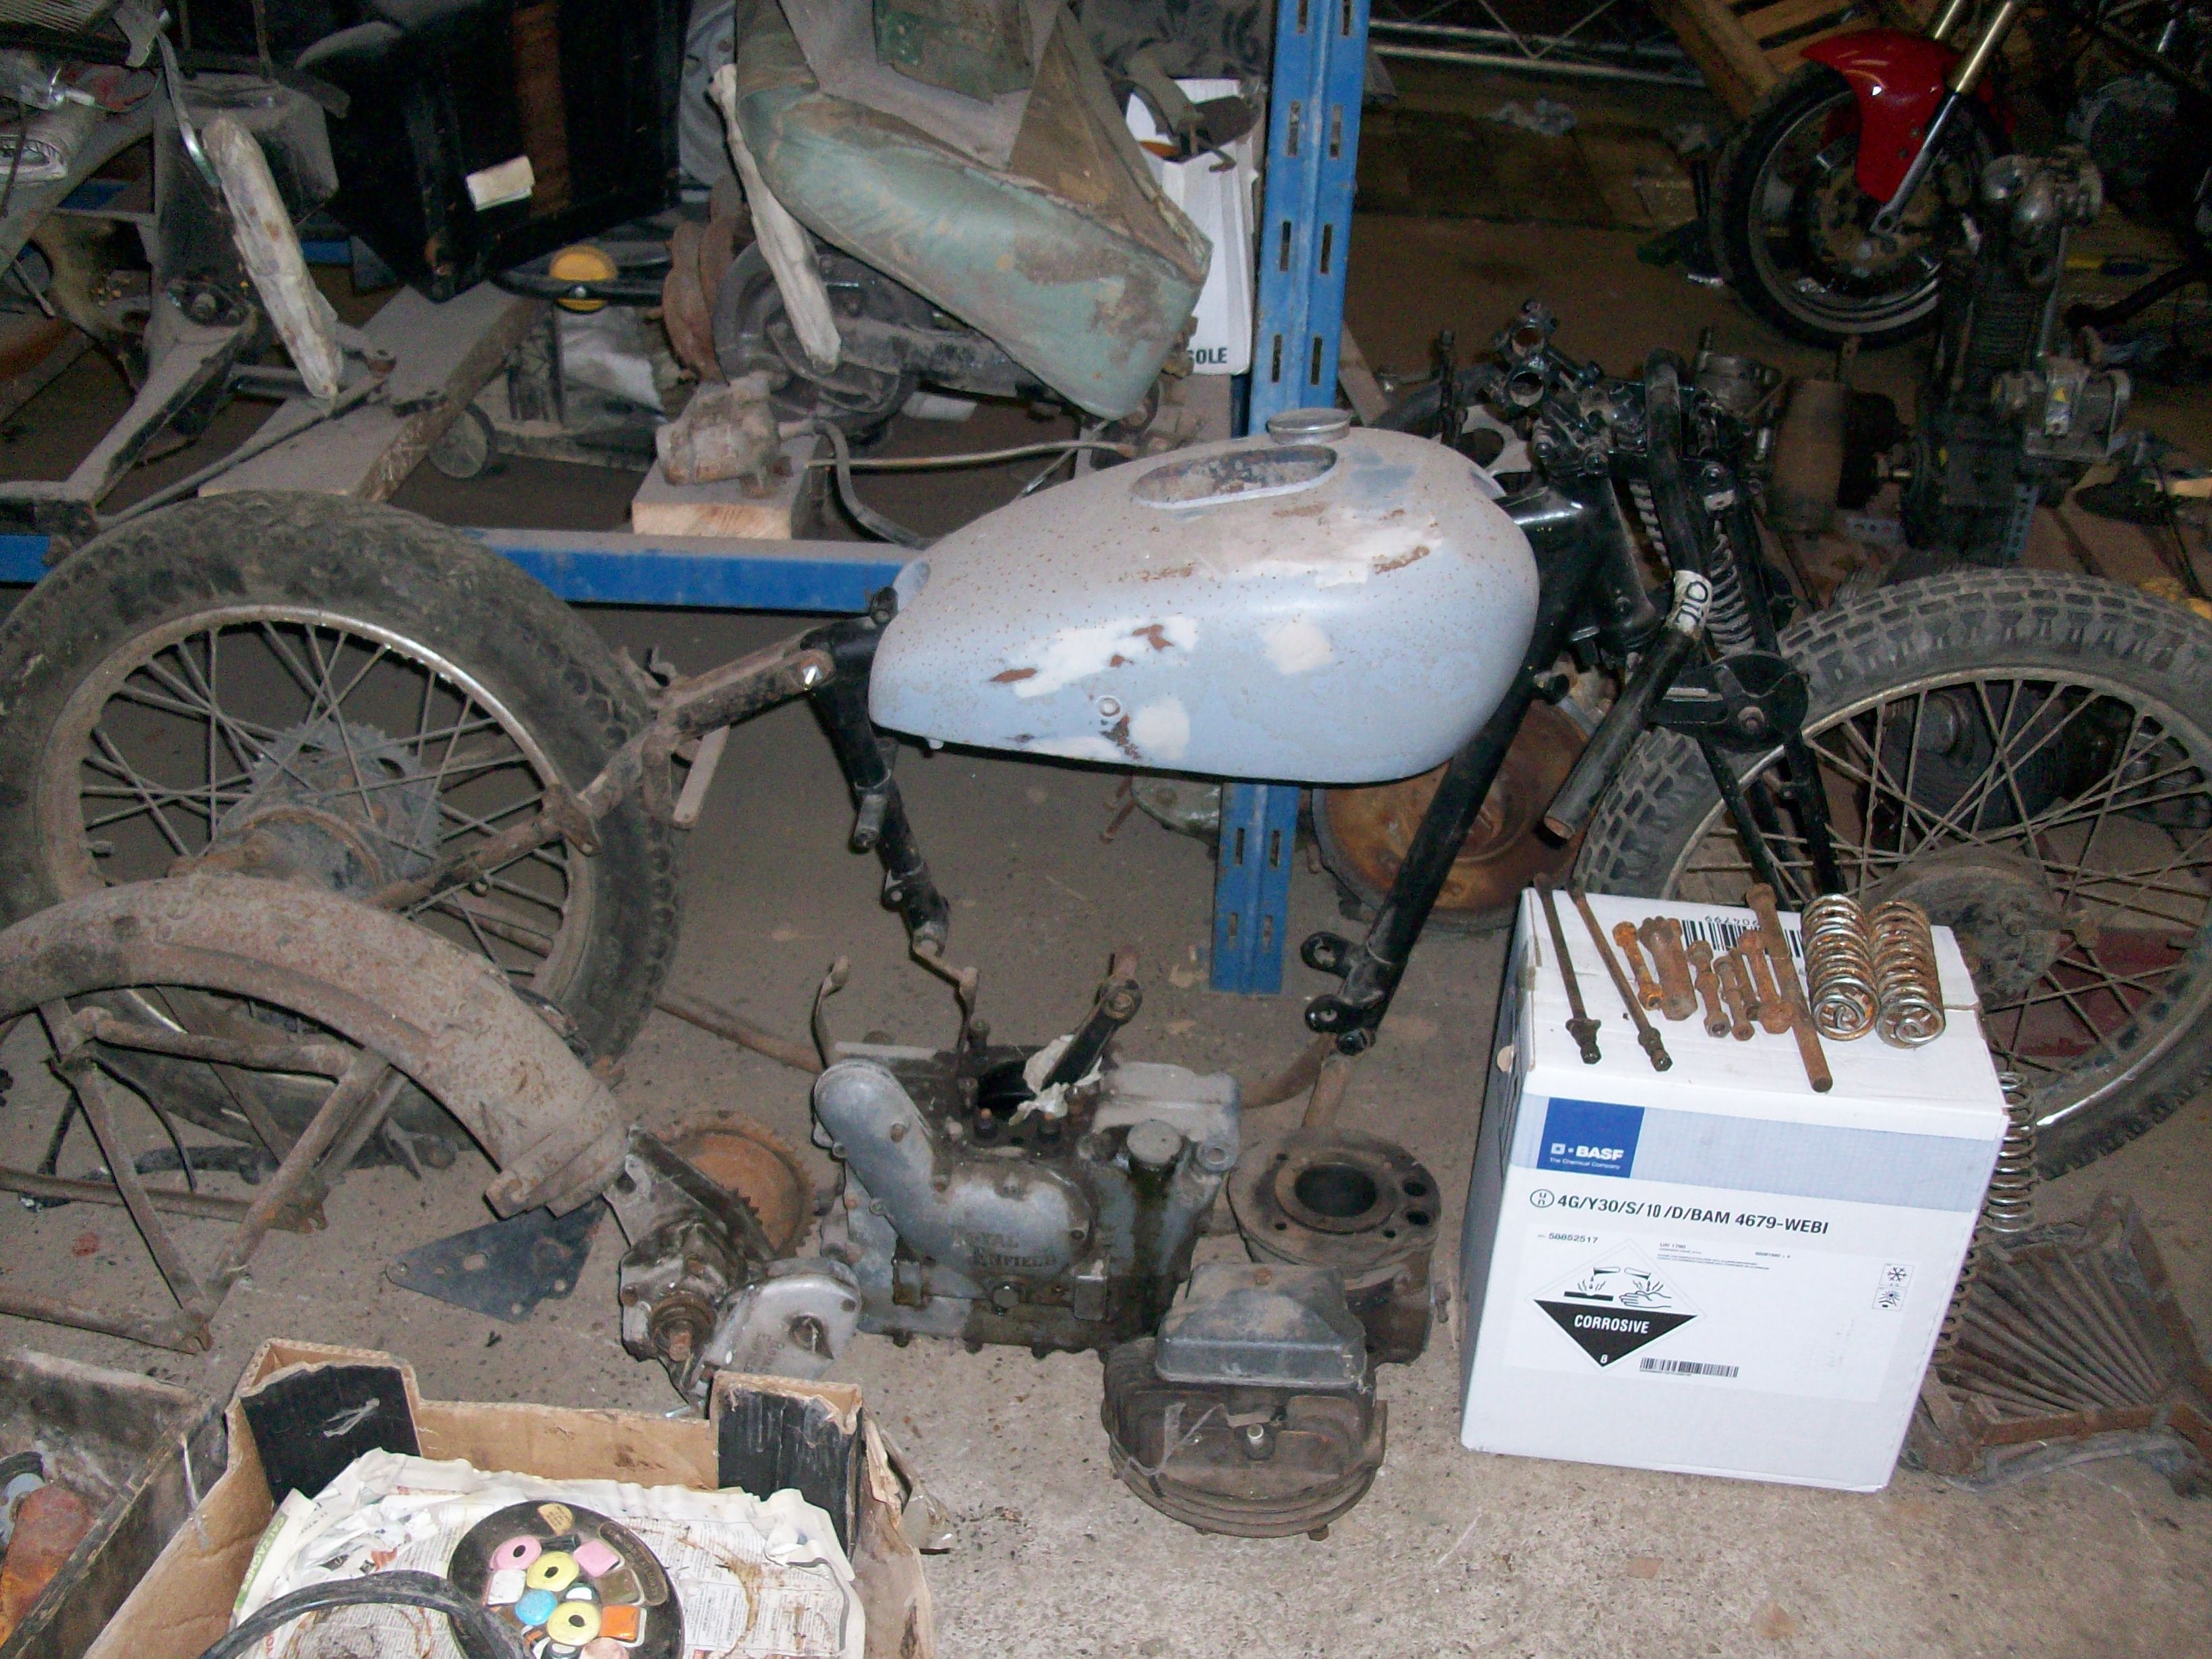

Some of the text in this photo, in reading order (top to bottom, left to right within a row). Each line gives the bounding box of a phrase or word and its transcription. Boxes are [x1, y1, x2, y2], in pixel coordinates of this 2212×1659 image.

[1675, 581, 1708, 625] OIL
[1575, 1145, 1624, 1161] BASF
[1562, 1158, 1591, 1167] Chemical
[1591, 1160, 1621, 1171] Company
[1735, 1213, 1830, 1235] 4679-WEBI
[1574, 1314, 1651, 1335] CORROSIVE
[1600, 1354, 1608, 1364] 8
